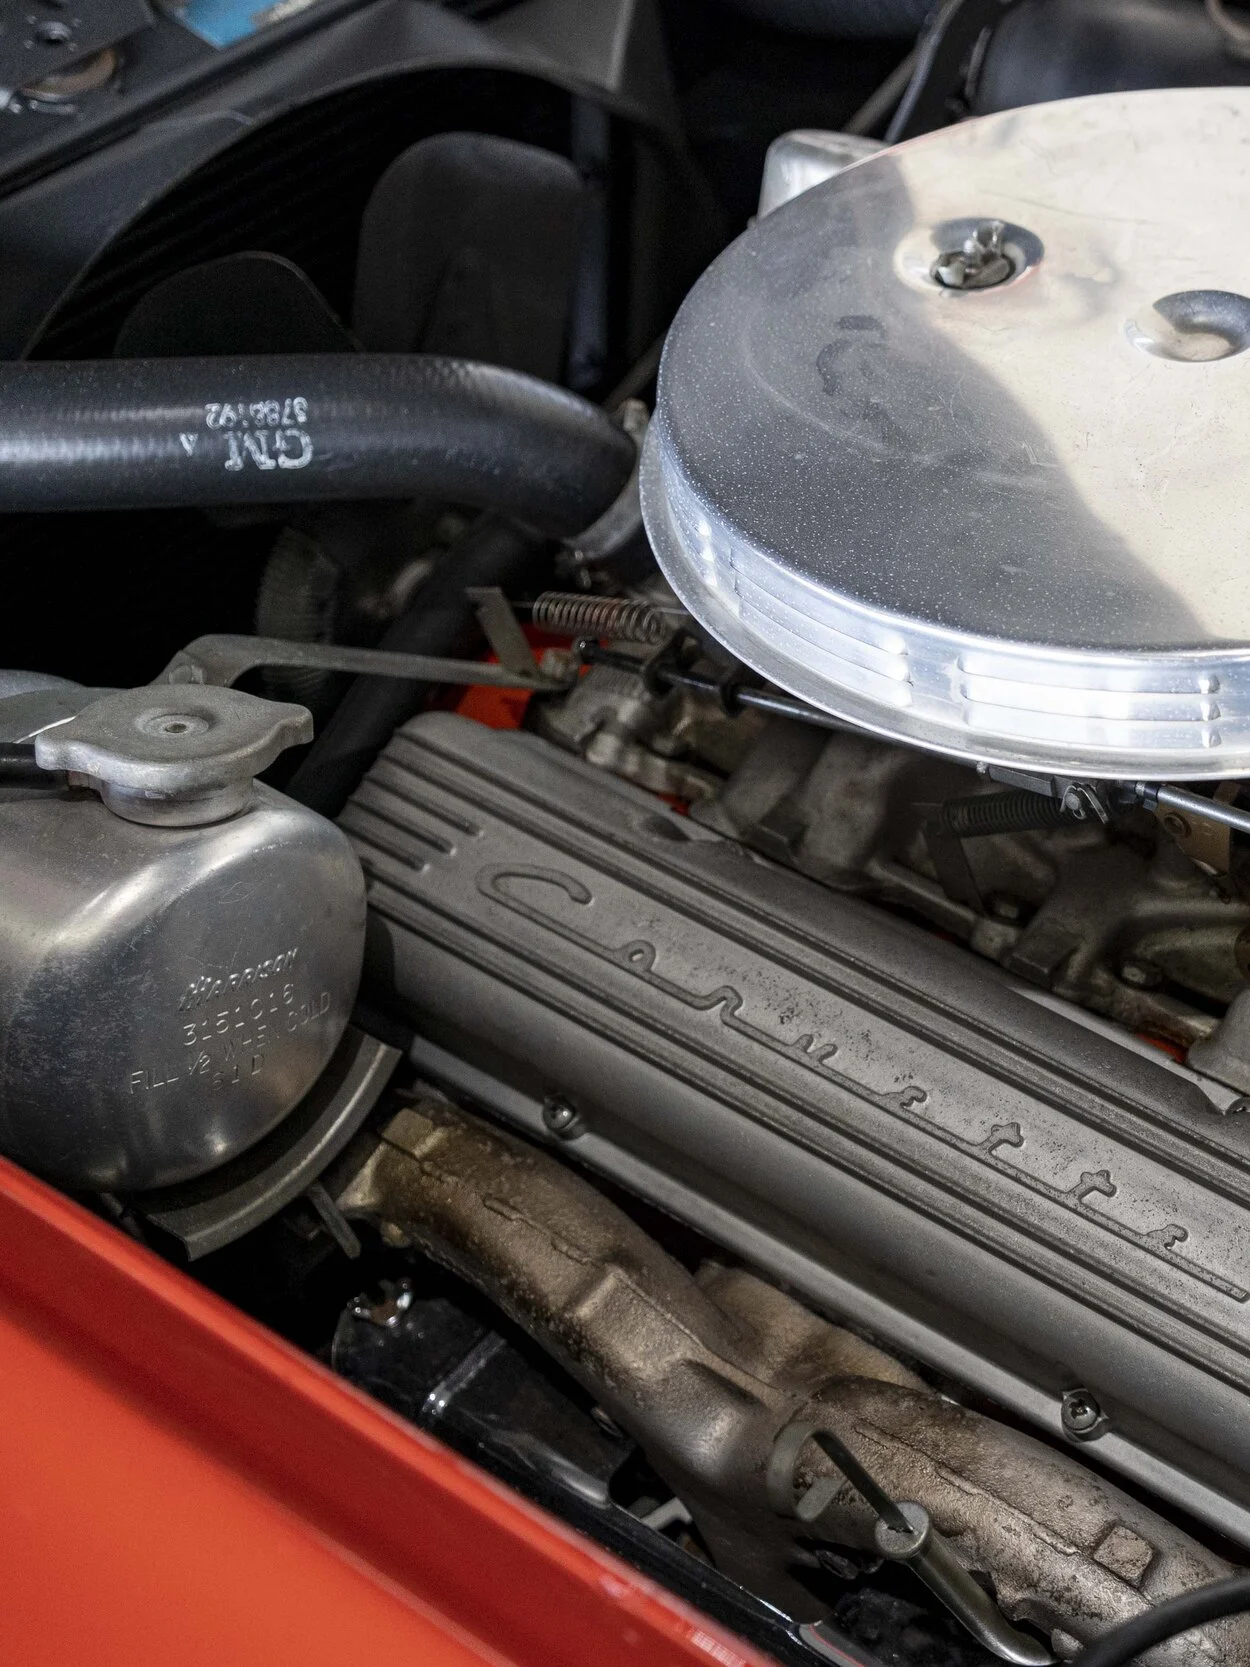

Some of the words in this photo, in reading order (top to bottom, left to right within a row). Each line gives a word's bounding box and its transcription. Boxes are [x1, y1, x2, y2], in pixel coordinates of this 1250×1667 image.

[224, 429, 313, 470] GM
[180, 948, 298, 1010] HARRISON
[184, 984, 293, 1045] 3151016
[130, 1070, 180, 1094] FILL
[477, 865, 1250, 1303] Corvette
